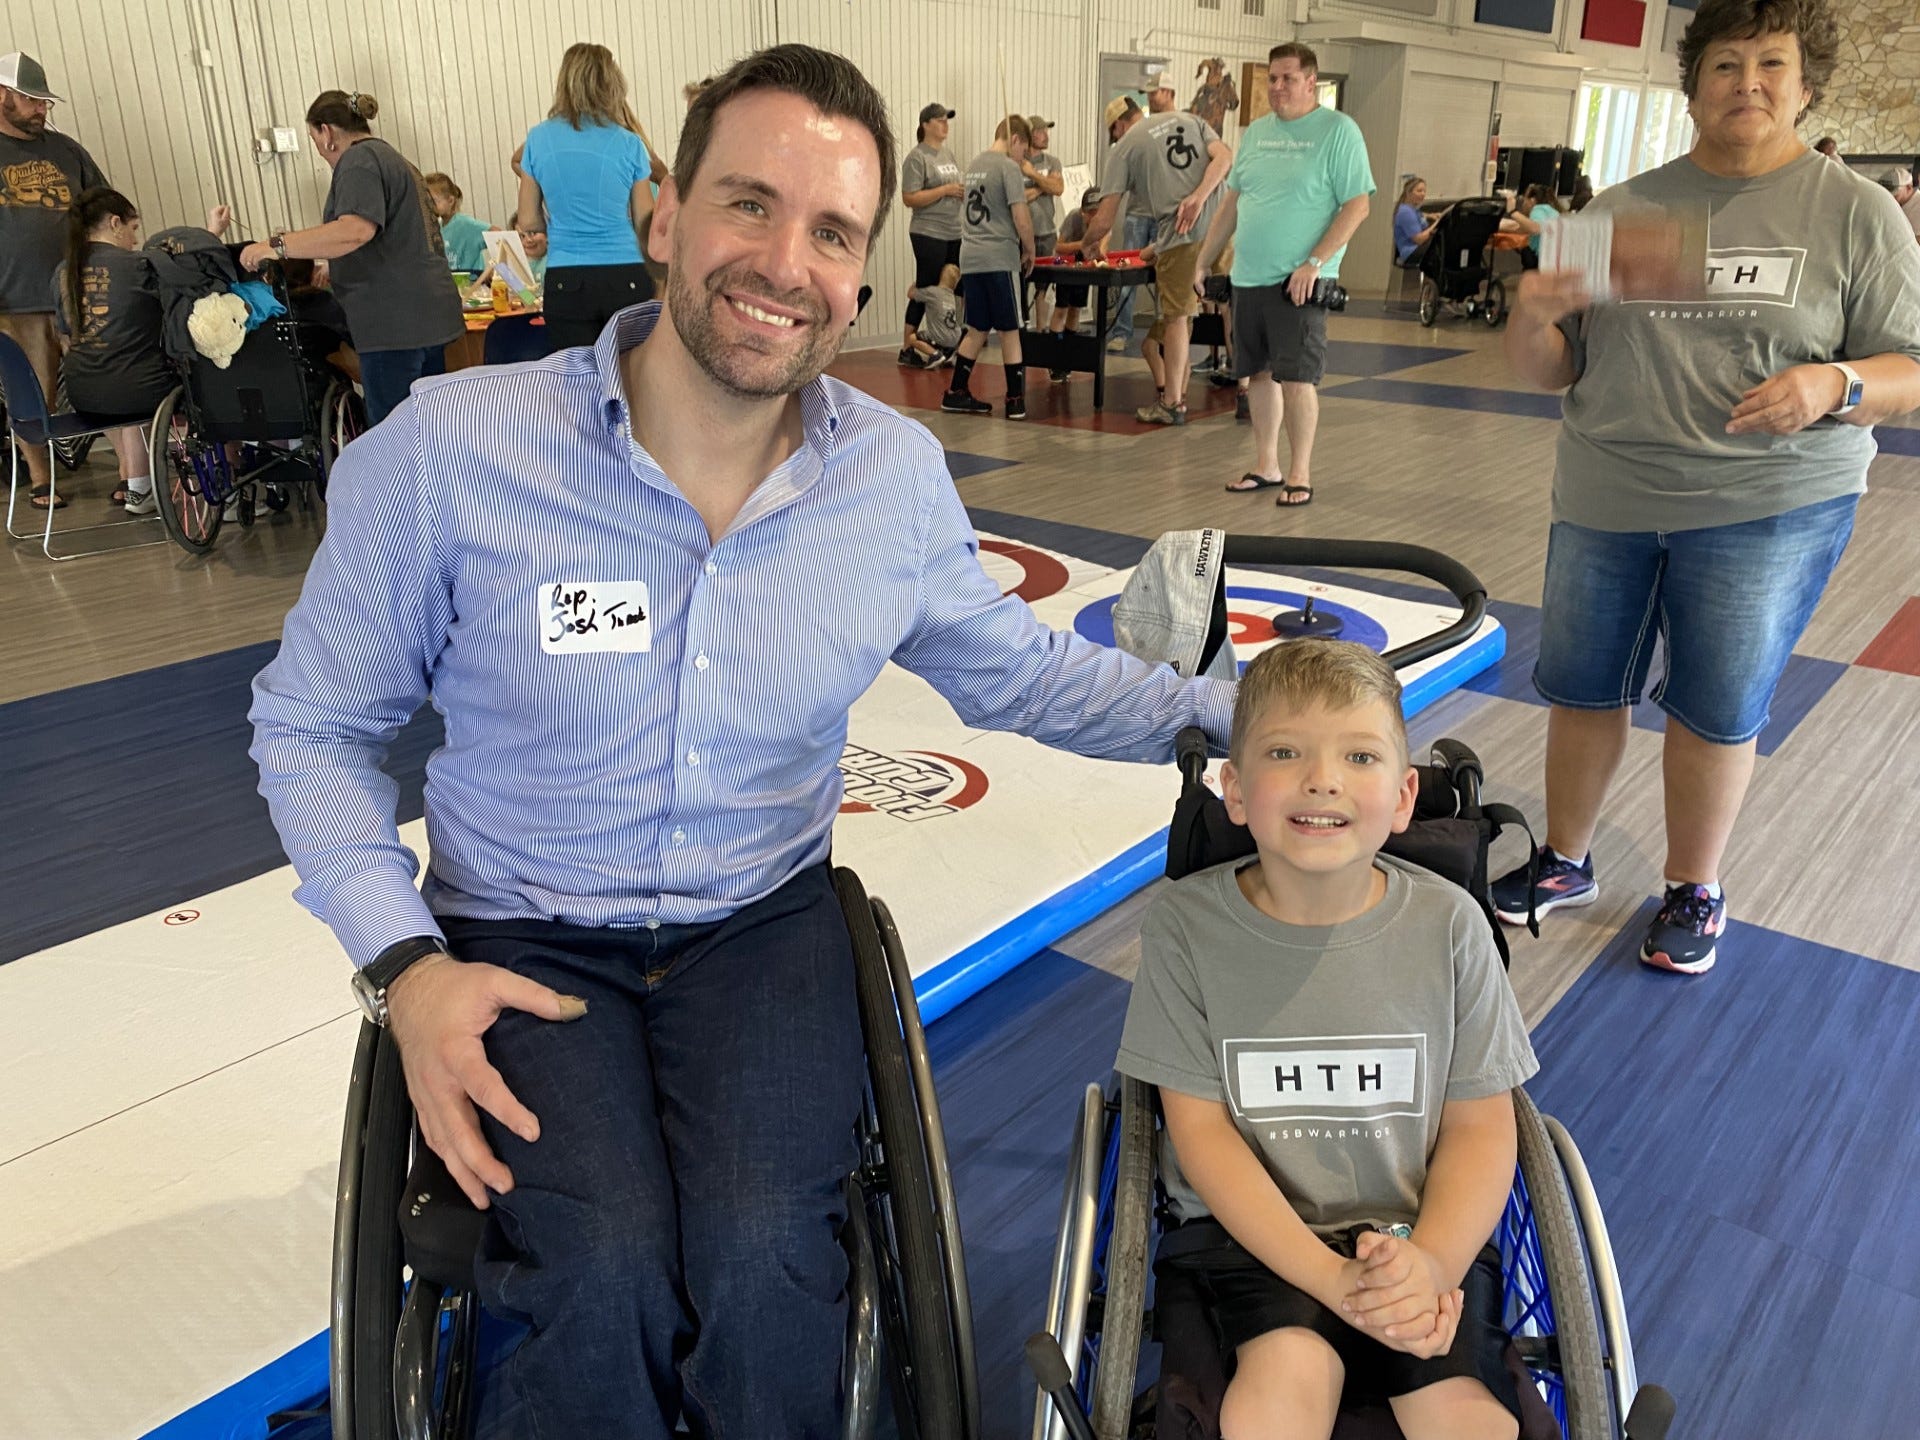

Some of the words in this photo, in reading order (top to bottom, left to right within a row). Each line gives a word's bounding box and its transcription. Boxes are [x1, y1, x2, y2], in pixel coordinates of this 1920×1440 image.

[1706, 265, 1759, 285] TH
[1648, 309, 1758, 319] #SBWARRIOR
[549, 608, 599, 643] Josh
[841, 767, 959, 823] FLOO
[1274, 1063, 1382, 1093] HTH
[1269, 1127, 1391, 1140] #SBWARRIOR
